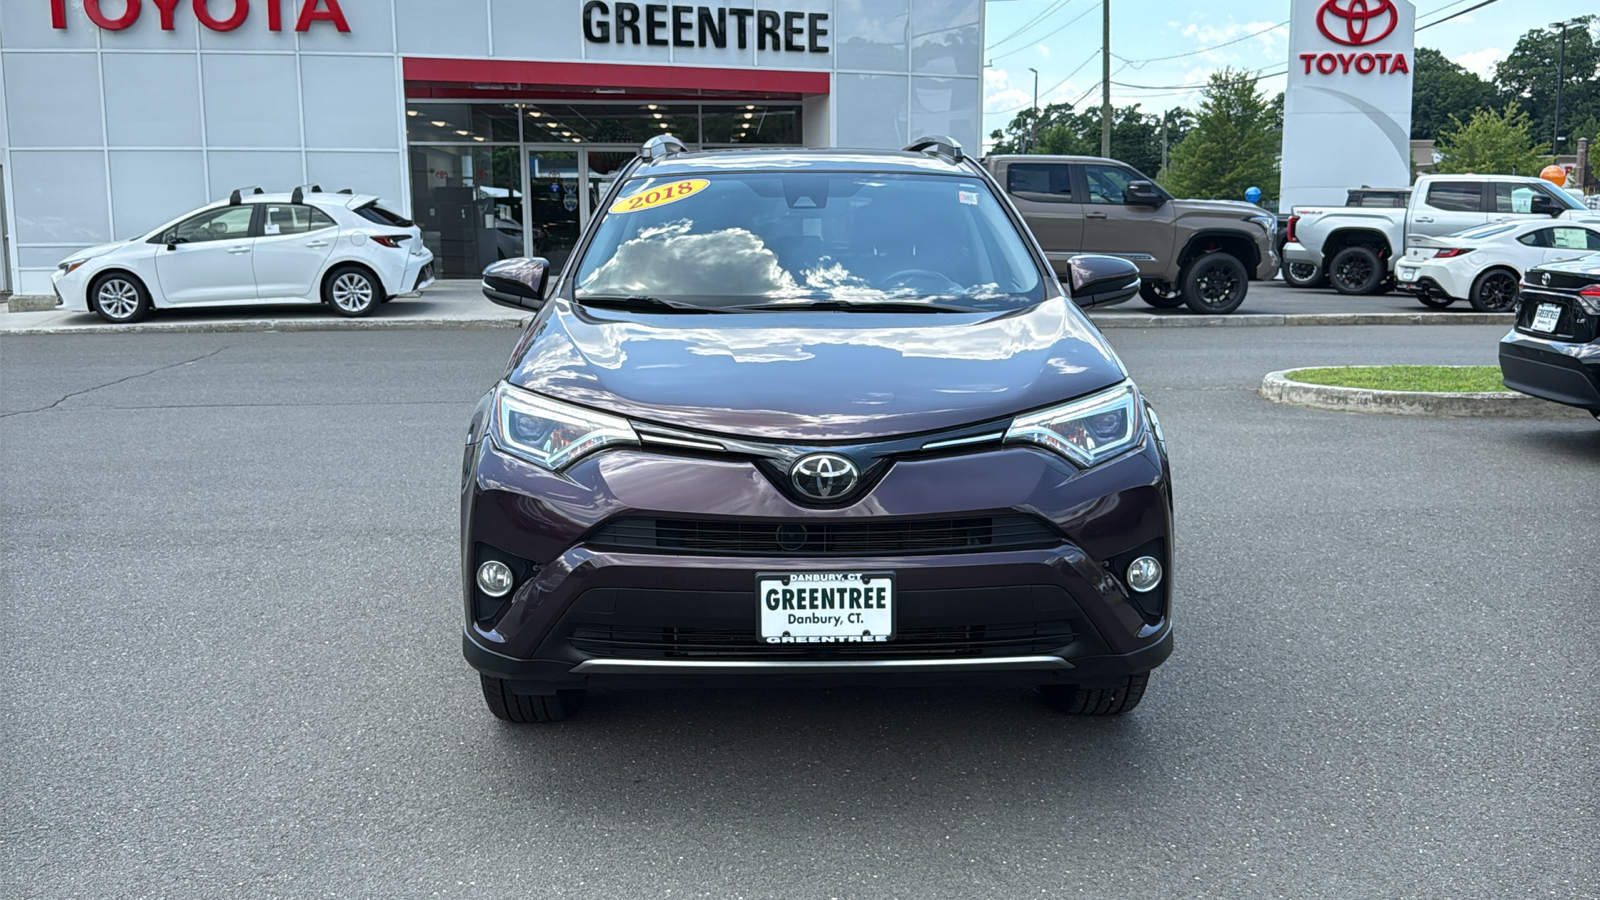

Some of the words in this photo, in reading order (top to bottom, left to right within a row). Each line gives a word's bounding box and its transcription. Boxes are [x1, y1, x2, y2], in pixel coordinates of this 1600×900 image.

[582, 0, 830, 53] GREENTREE
[1299, 53, 1409, 74] TOYOTA
[628, 181, 693, 210] 2018
[789, 574, 845, 582] DANBURY,
[847, 573, 863, 582] CT
[765, 587, 887, 611] GREENTREE
[788, 612, 844, 627] Danbury,
[847, 612, 864, 624] CT.
[766, 635, 888, 644] GREENTREE
